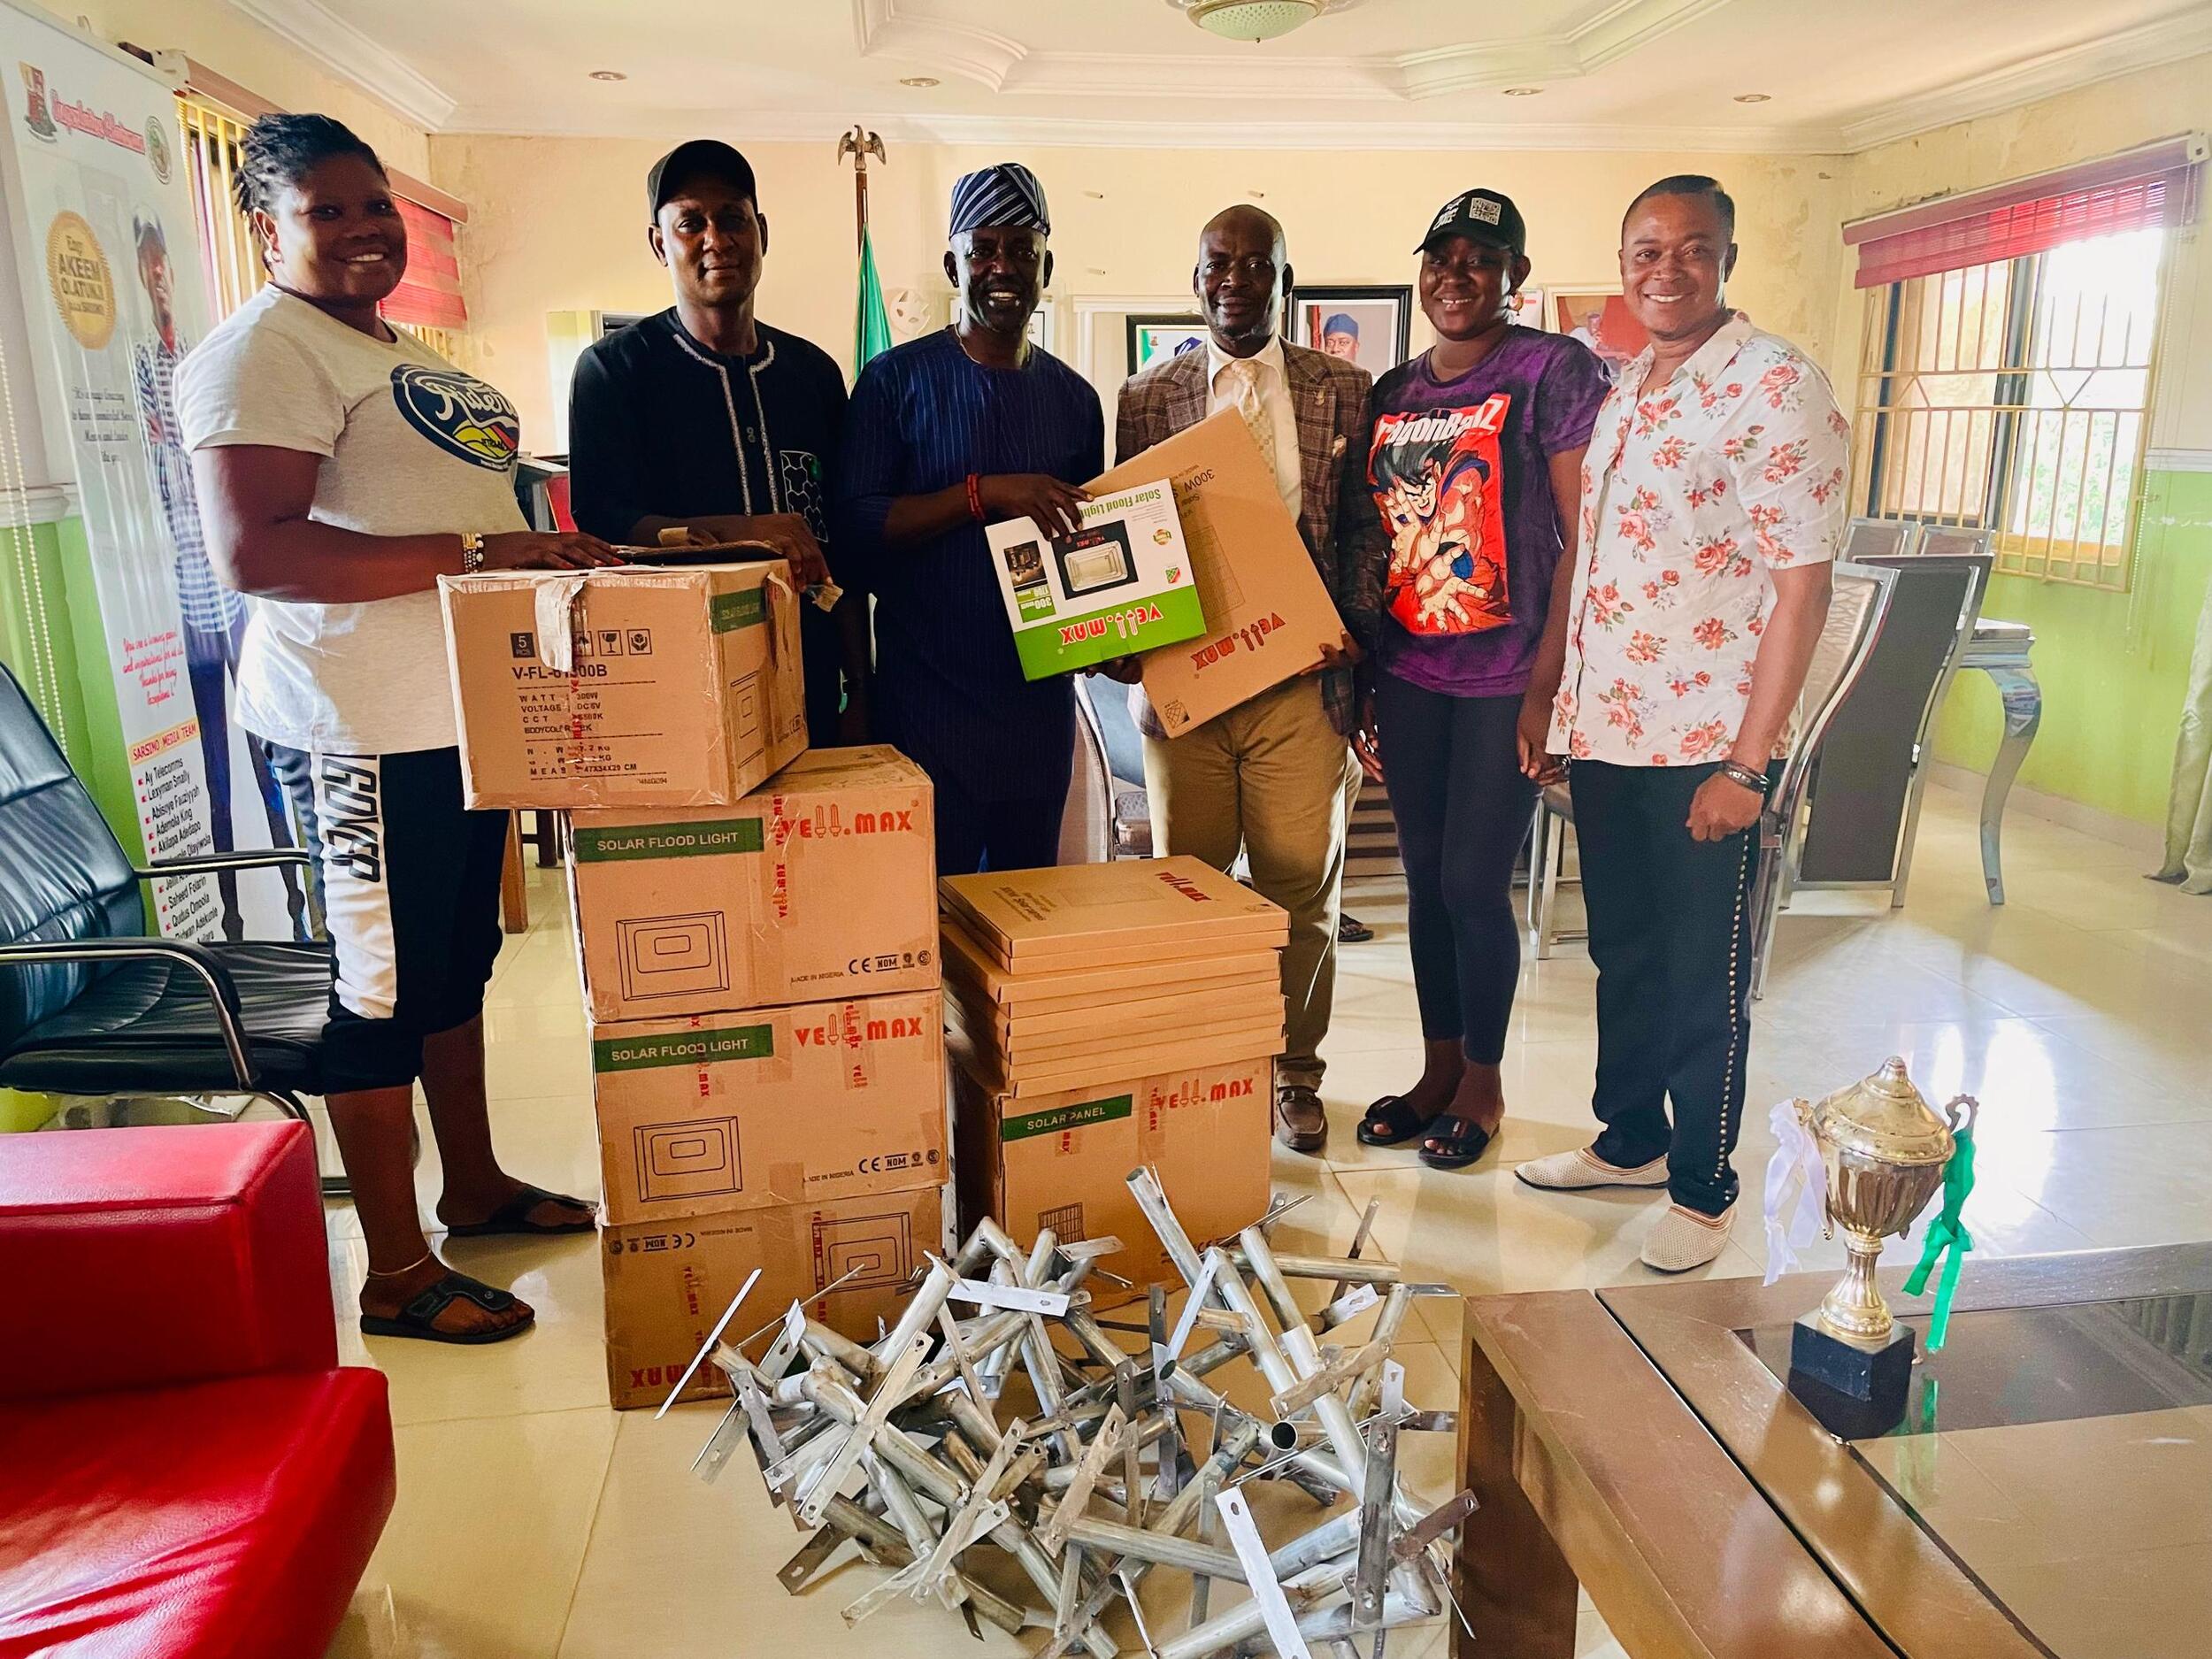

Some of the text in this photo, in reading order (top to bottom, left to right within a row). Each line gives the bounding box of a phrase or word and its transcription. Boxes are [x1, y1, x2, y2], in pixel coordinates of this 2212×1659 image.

[1184, 469, 1215, 493] 300W
[1105, 496, 1133, 512] Flood
[1135, 488, 1162, 503] Solar
[518, 636, 527, 649] 5
[162, 731, 180, 746] MEDIA
[181, 723, 196, 738] TEAM
[597, 832, 739, 851] SOLAR FLOOD LIGHT
[611, 1039, 749, 1061] SOLAR FLOOD LIGHT
[1027, 1107, 1106, 1130] SOLAR PANEL
